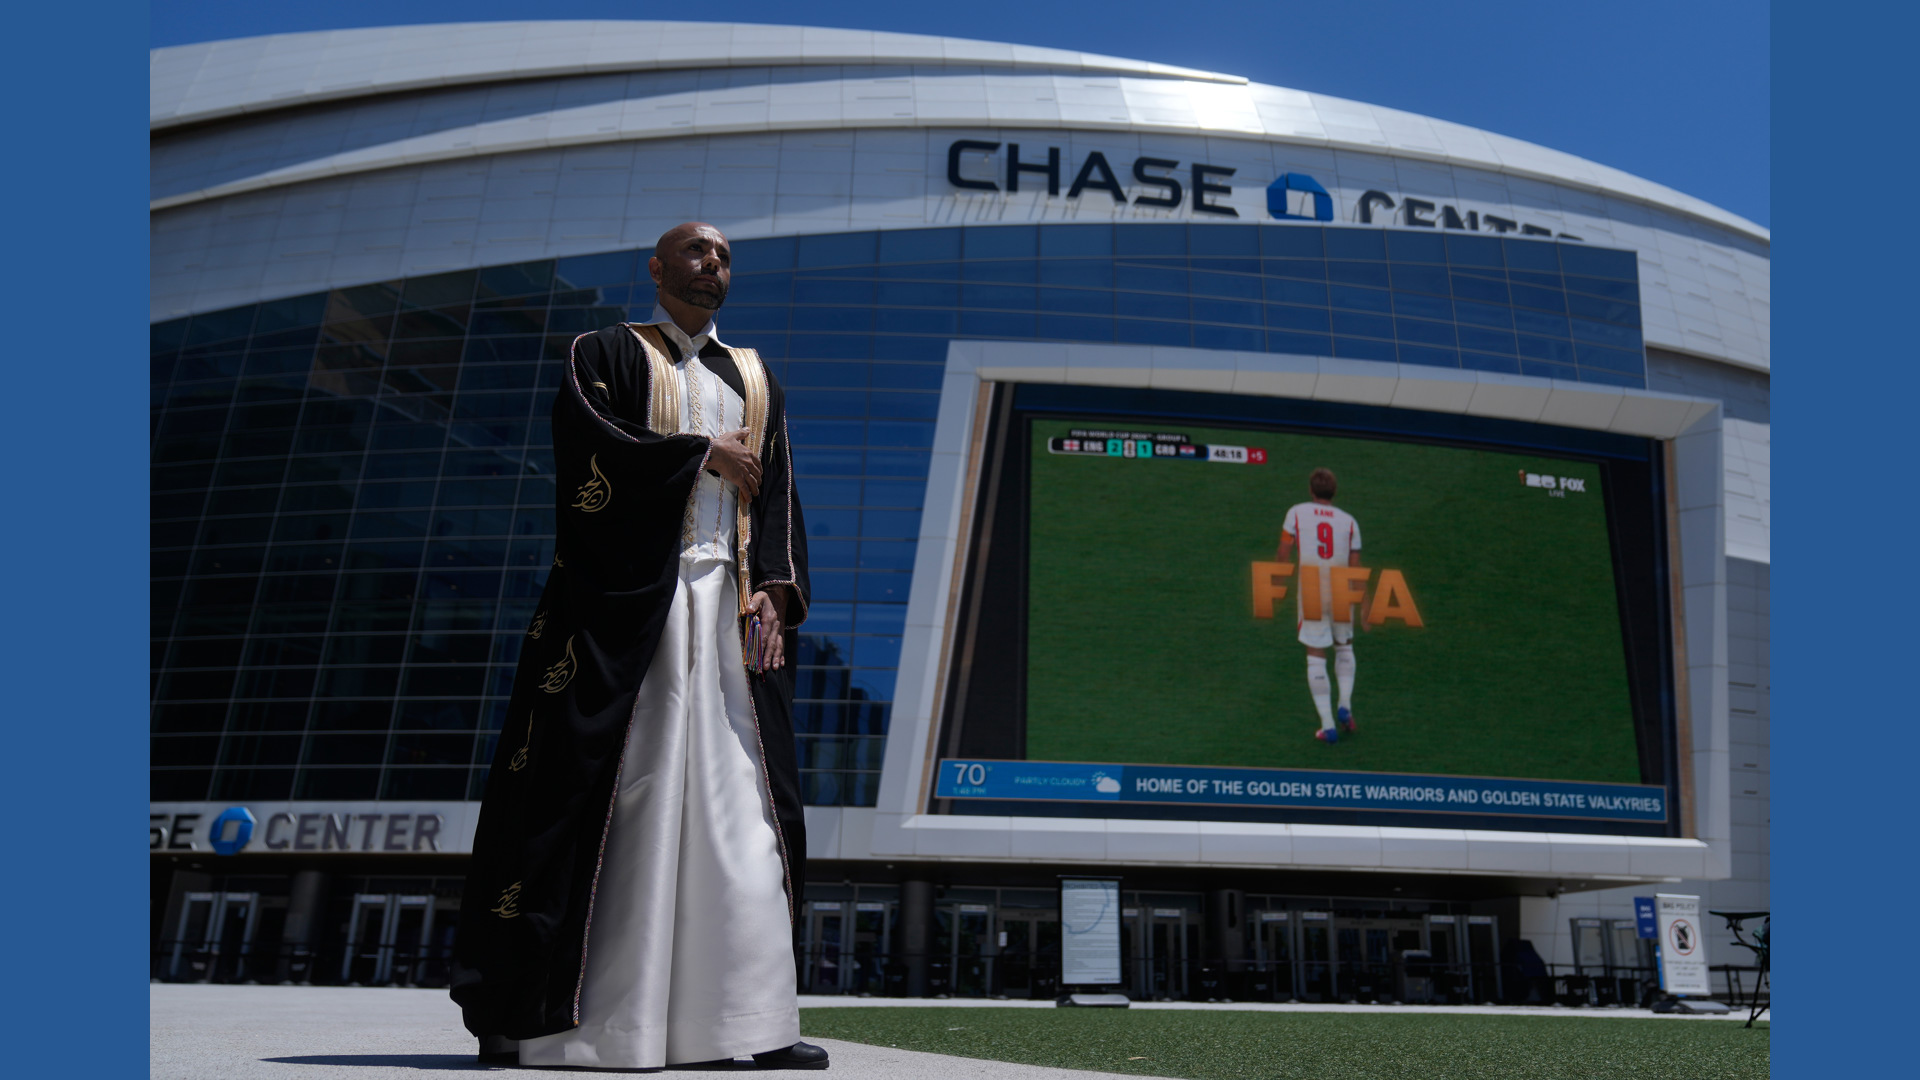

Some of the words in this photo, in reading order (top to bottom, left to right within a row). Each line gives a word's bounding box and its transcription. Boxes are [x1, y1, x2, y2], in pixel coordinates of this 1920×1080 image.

[948, 139, 1239, 217] CHASE
[1088, 430, 1114, 438] WORLD
[1083, 440, 1104, 452] ENG
[1155, 443, 1177, 456] CRO
[1559, 476, 1586, 493] FOX
[1549, 489, 1566, 498] LIVE
[1314, 508, 1335, 518] KANE
[1316, 521, 1334, 560] 9
[1251, 561, 1425, 628] FIFA
[1014, 776, 1049, 785] PARTLY
[1050, 777, 1087, 786] CLOUDY
[1136, 778, 1183, 793] HOME
[1187, 779, 1209, 794] OF
[1212, 780, 1243, 795] THE
[1247, 781, 1312, 797] GOLDEN
[1315, 783, 1362, 799] STATE
[1364, 785, 1445, 802] WARRIORS
[1447, 788, 1478, 804] AND
[1481, 790, 1540, 806] GOLDEN
[1543, 793, 1586, 808] STATE
[1588, 795, 1662, 813] VALKYRIES
[265, 812, 444, 851] CENTER
